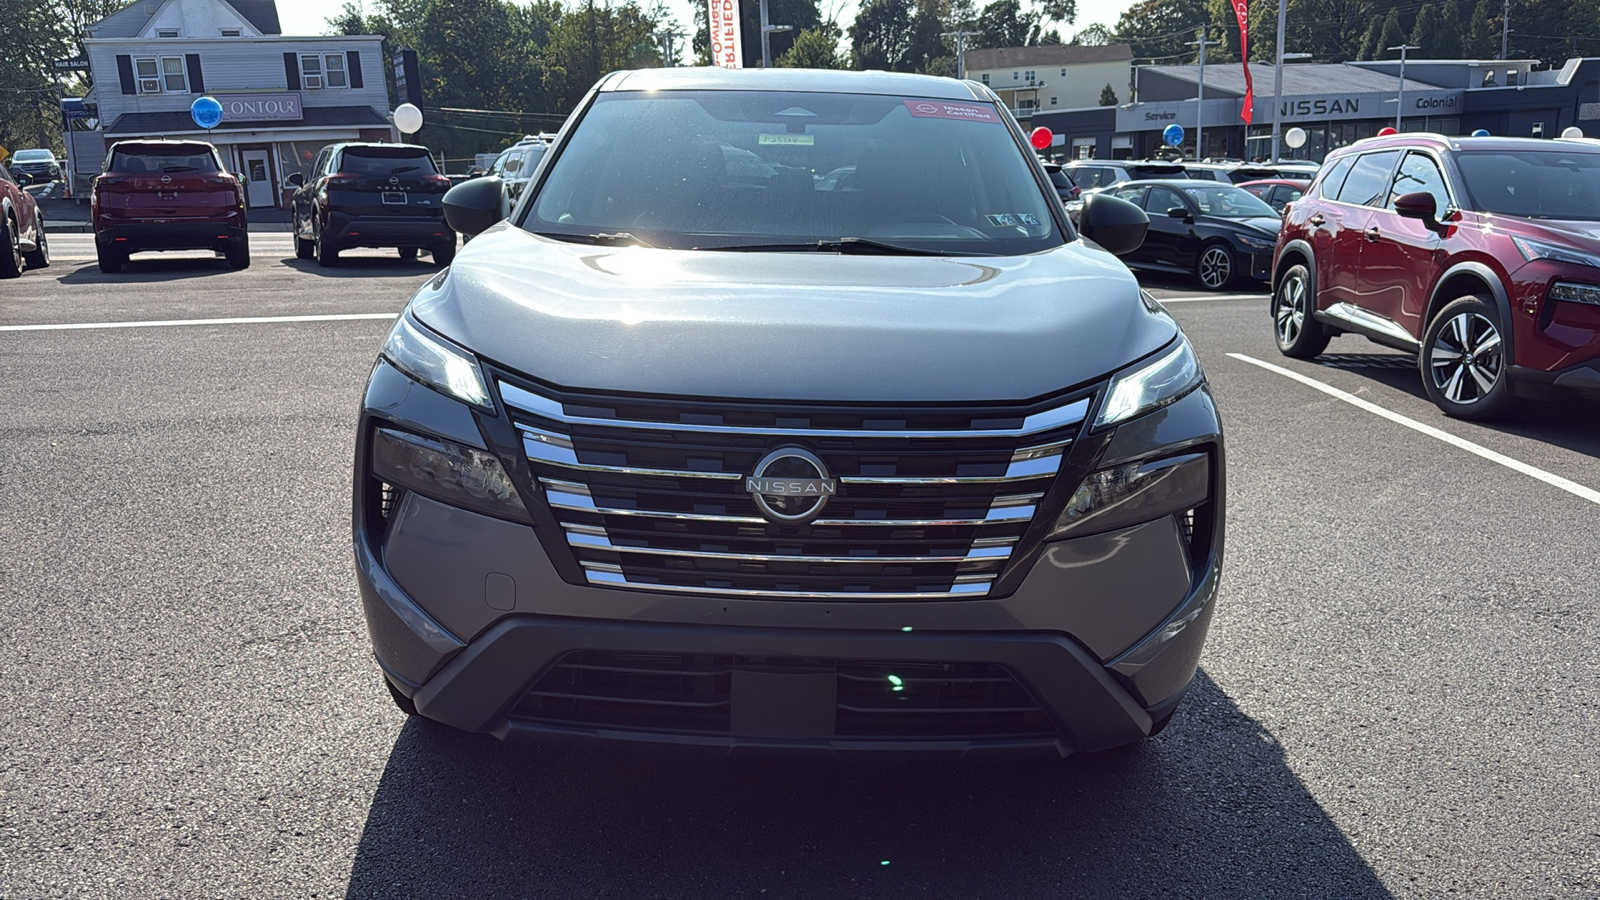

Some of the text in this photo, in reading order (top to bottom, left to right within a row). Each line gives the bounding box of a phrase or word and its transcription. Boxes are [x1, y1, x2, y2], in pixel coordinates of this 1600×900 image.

[222, 100, 295, 115] CONTOUR
[1416, 96, 1458, 109] Colonial
[943, 105, 979, 113] Nissan
[947, 110, 991, 119] Certified
[1145, 111, 1176, 121] Service
[748, 480, 834, 493] NISSAN
